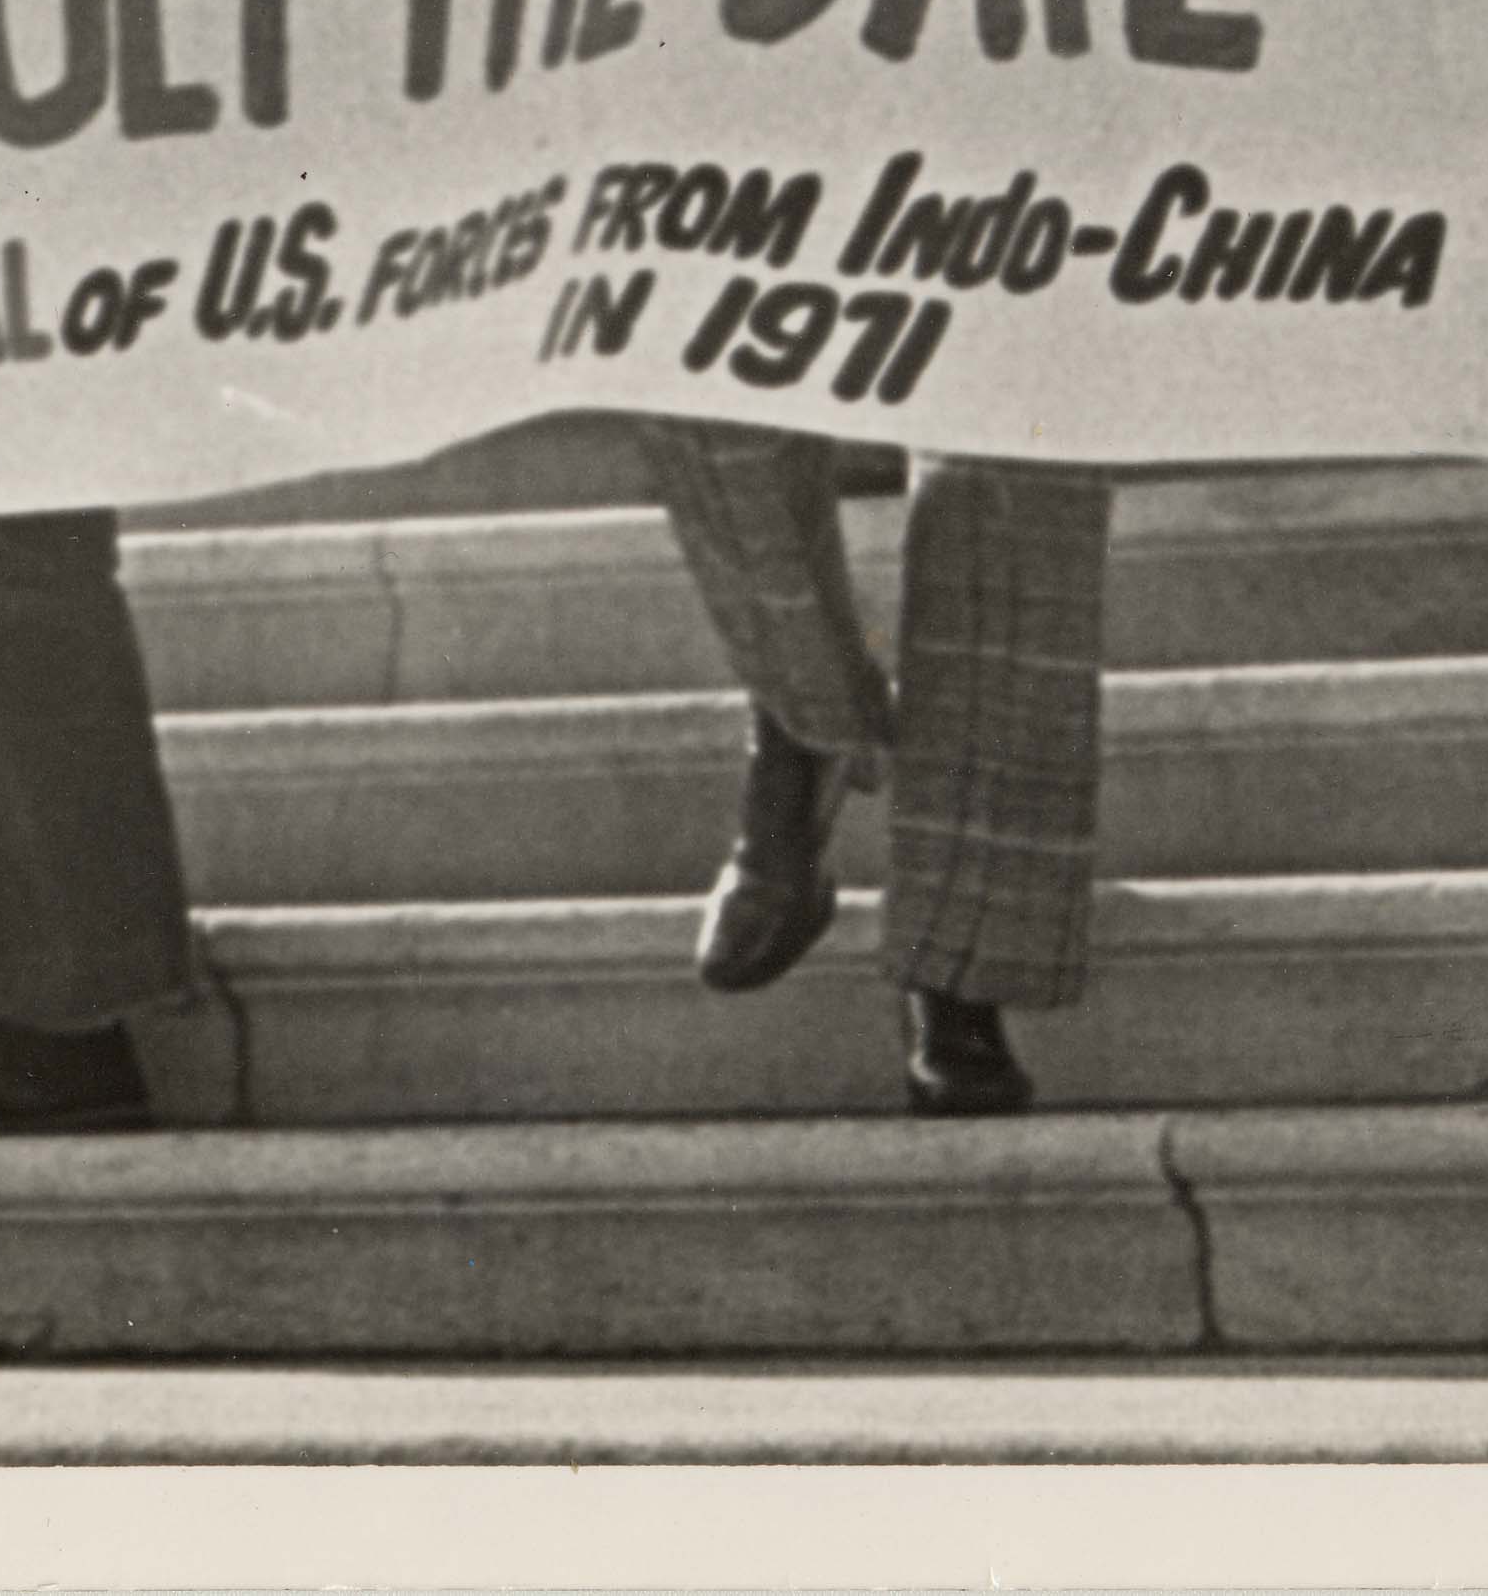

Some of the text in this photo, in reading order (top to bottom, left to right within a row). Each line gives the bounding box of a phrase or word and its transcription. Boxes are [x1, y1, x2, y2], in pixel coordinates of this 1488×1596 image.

[60, 259, 180, 357] OF
[194, 200, 343, 343] U.S.
[571, 163, 823, 269] FROM
[541, 266, 951, 405] IN 1971
